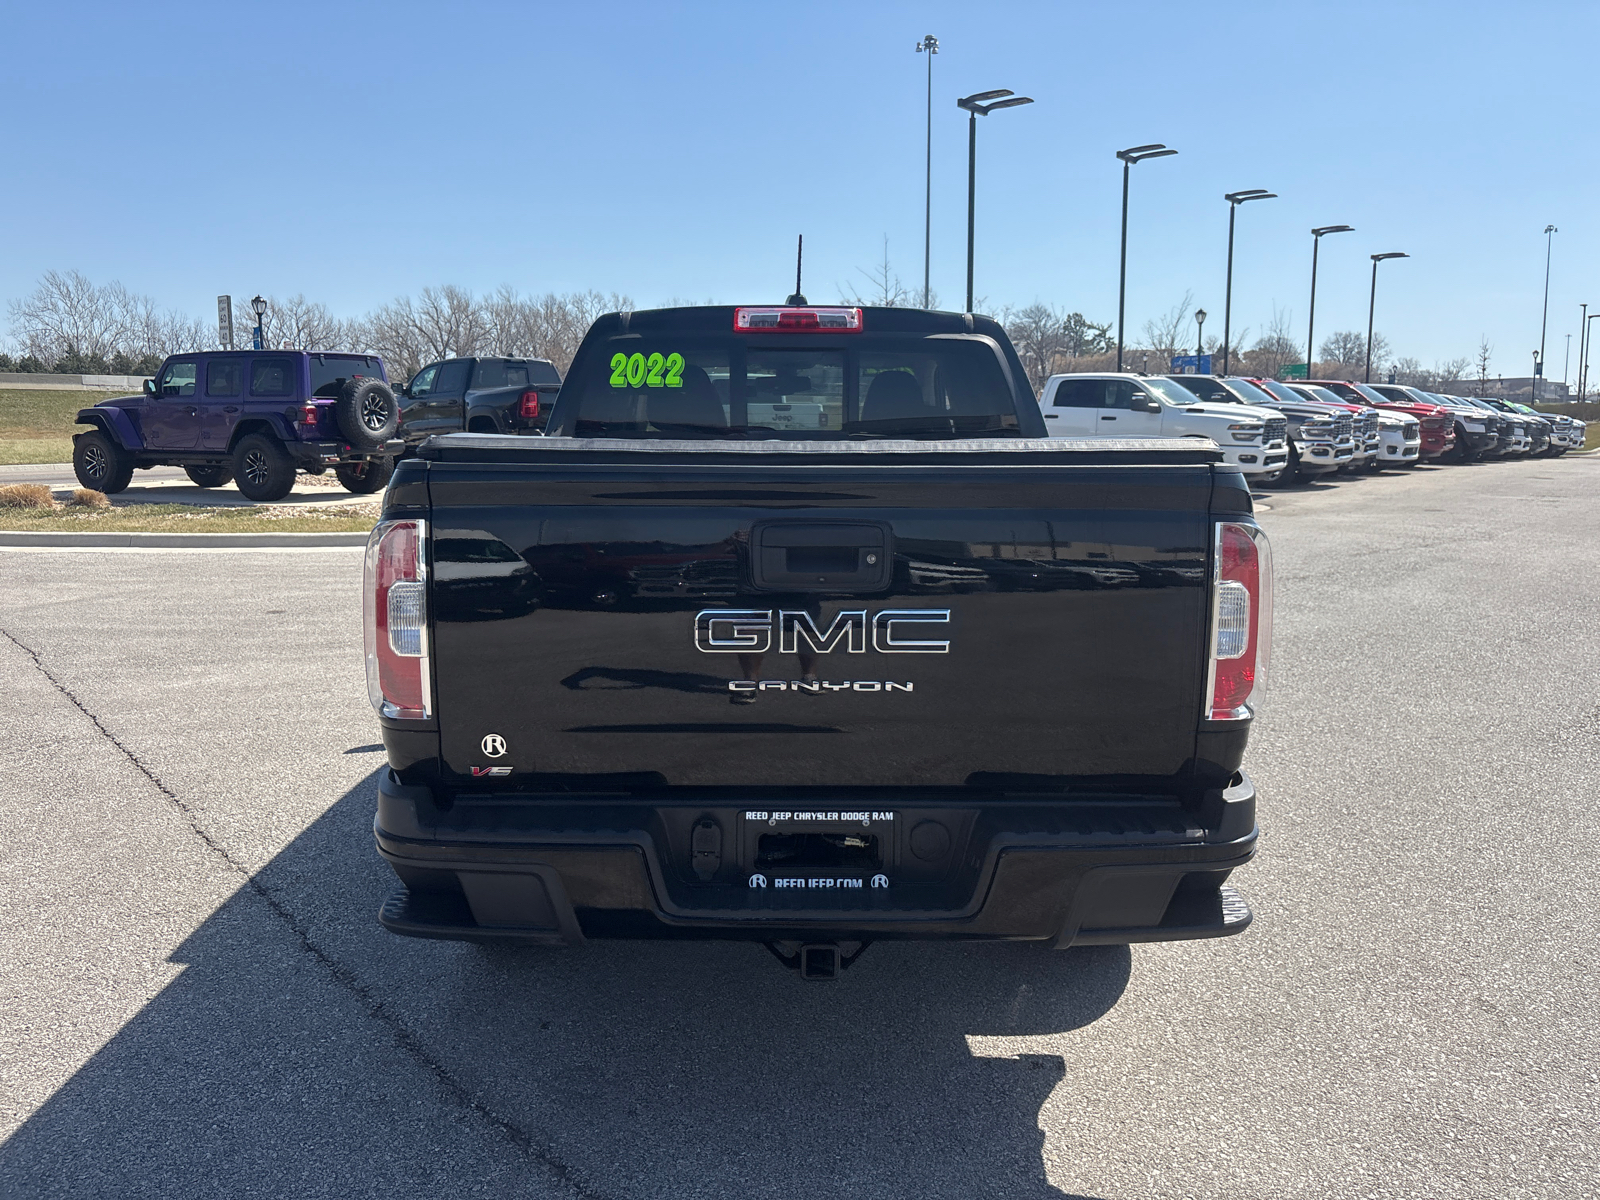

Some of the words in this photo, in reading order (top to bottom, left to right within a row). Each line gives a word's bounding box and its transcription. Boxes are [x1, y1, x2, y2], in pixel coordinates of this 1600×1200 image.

[609, 352, 685, 389] 2022
[772, 414, 793, 422] Jeep
[694, 608, 951, 654] GMC
[728, 680, 914, 692] CANYON
[470, 766, 514, 777] V6
[746, 811, 768, 820] REED
[771, 811, 792, 821] JEEP
[793, 811, 838, 821] CHRYSLER
[841, 812, 870, 821] DODGE
[872, 812, 894, 821] RAM
